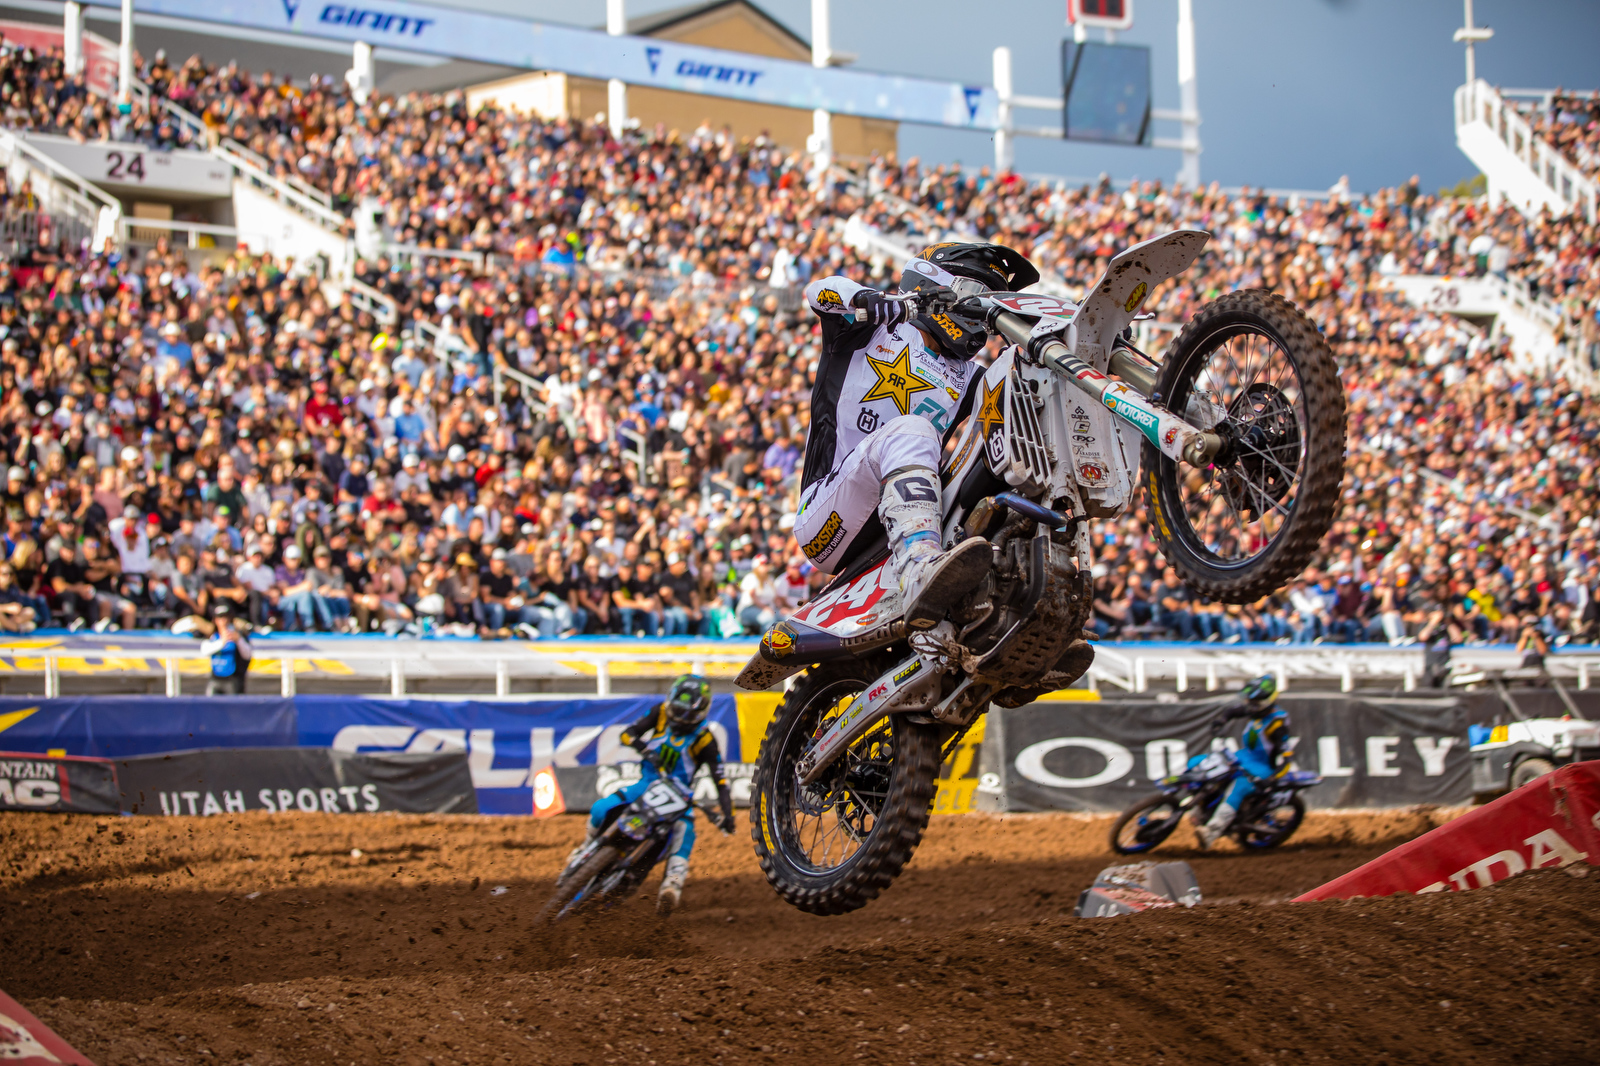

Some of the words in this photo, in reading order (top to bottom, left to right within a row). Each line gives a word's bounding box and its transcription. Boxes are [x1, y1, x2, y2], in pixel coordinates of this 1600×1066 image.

[319, 5, 436, 36] GIANT
[676, 61, 766, 86] GIANT
[106, 152, 145, 180] 24
[1116, 401, 1157, 428] MOTOREX
[803, 511, 842, 559] ROCKSTAR
[830, 527, 846, 547] DRINK
[894, 661, 920, 682] EXCEL
[868, 682, 888, 702] RK
[1144, 736, 1460, 782] OLEY
[159, 790, 246, 816] UTAH
[259, 783, 381, 815] SPORTS
[642, 783, 688, 816] 57
